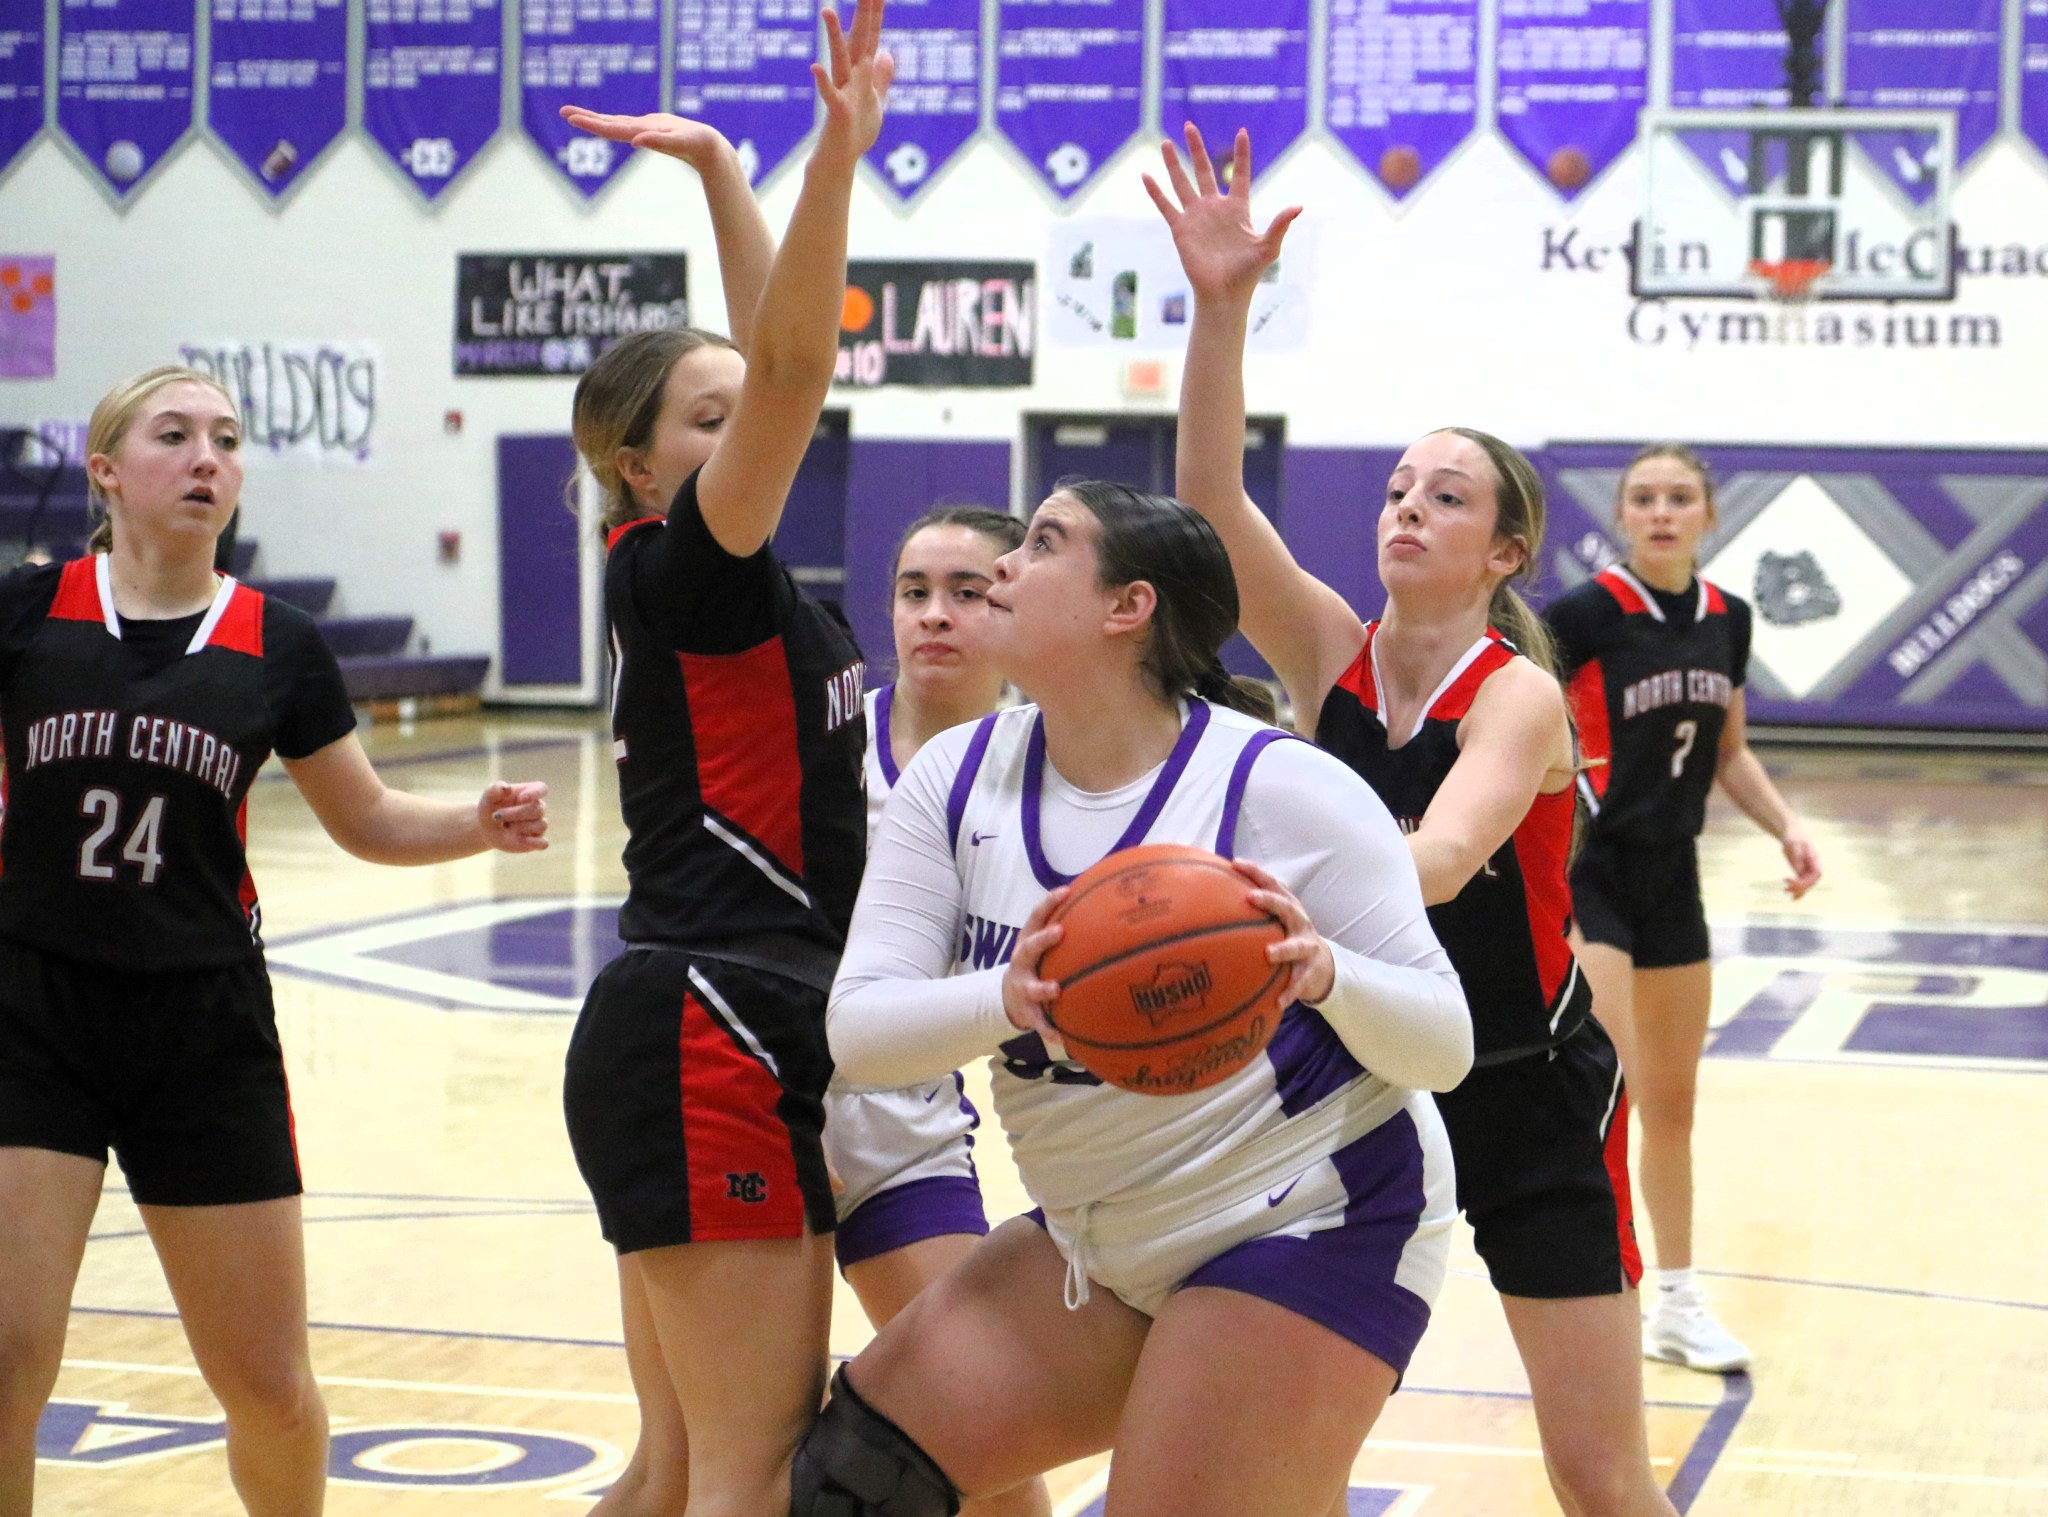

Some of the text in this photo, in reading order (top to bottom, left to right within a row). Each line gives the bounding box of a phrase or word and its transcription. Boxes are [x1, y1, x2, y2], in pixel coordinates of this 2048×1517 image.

[471, 296, 554, 337] LIKE
[881, 278, 1036, 357] LAUREN
[1626, 300, 2003, 350] Gymnasium
[1624, 670, 1682, 719] NORTH
[26, 711, 240, 800] NORTH CENTRAL
[79, 788, 165, 884] 24
